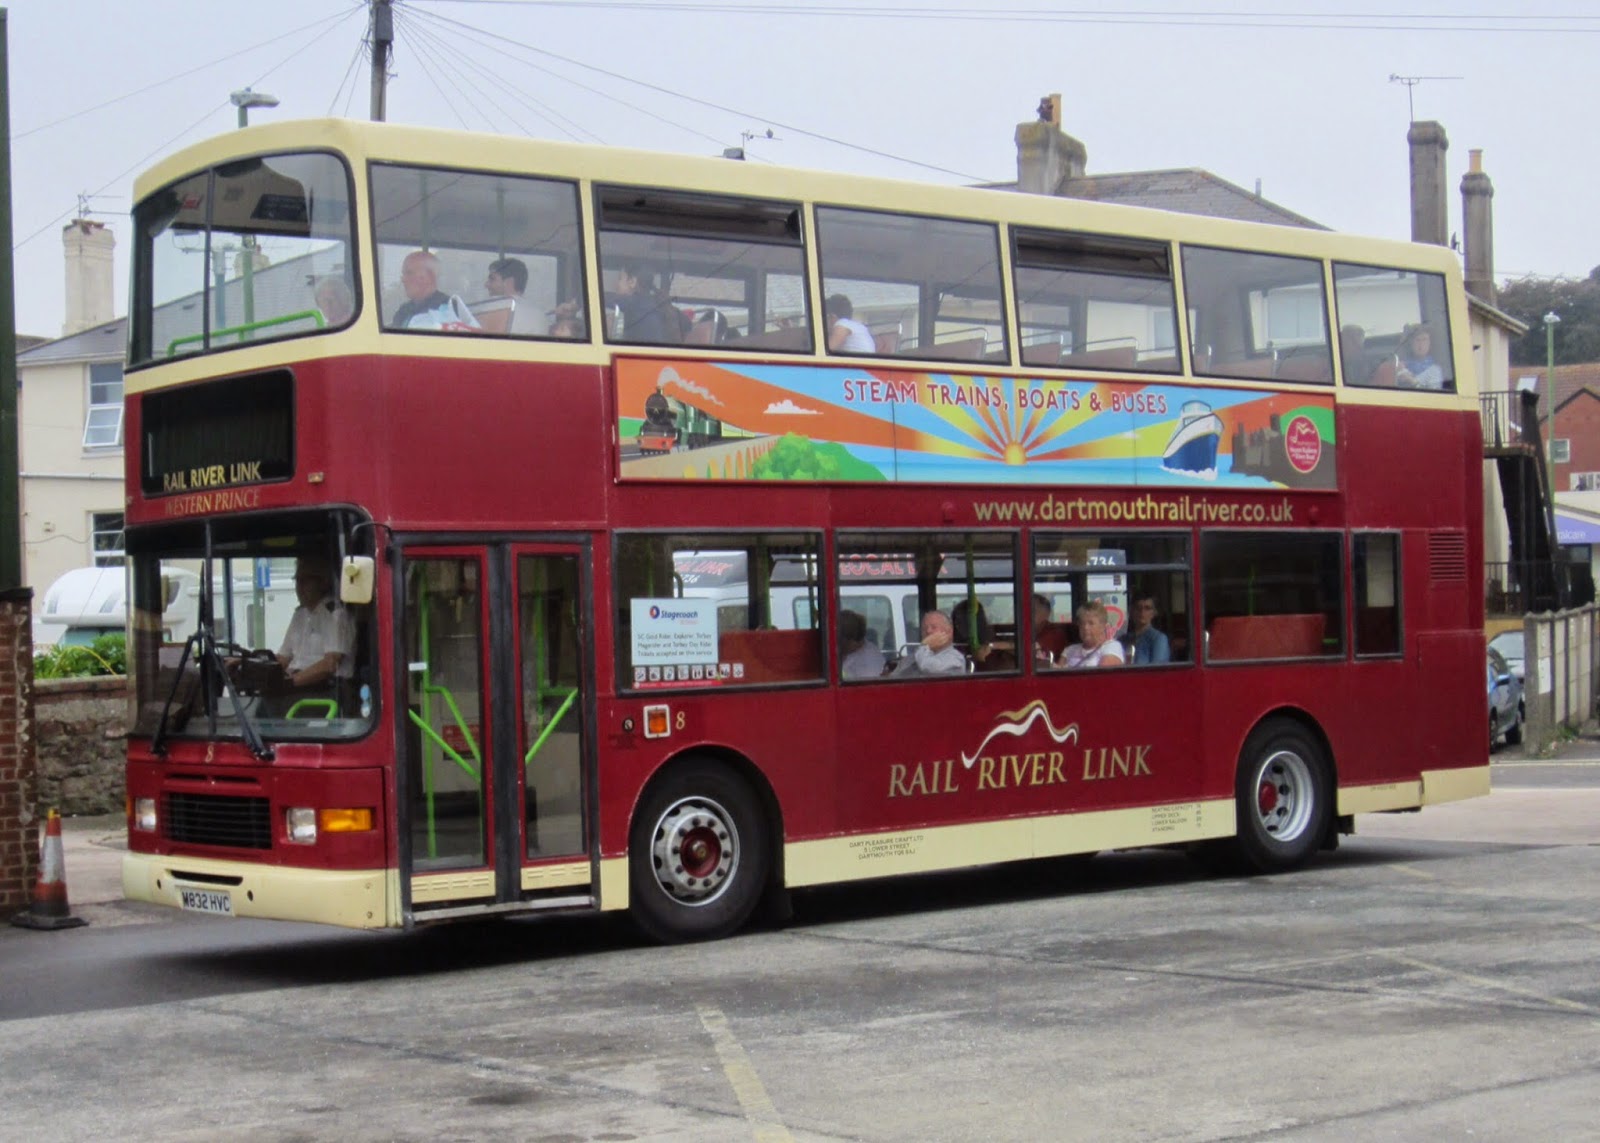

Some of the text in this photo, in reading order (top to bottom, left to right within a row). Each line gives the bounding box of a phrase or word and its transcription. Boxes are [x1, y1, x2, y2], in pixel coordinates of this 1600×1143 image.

[843, 379, 1168, 415] STEAM TRAINS, BOATS & BUSES
[163, 461, 261, 492] RAIL RIVER LINK
[165, 489, 260, 516] WESTERN PRINCE
[973, 494, 1294, 523] www.dartmouthrailriver.co.uk
[661, 610, 699, 621] Stagecoach
[676, 711, 685, 730] 8
[888, 745, 1152, 798] RAIL RIVER LINK
[865, 838, 893, 846] PLEASURE
[210, 894, 231, 912] HVC
